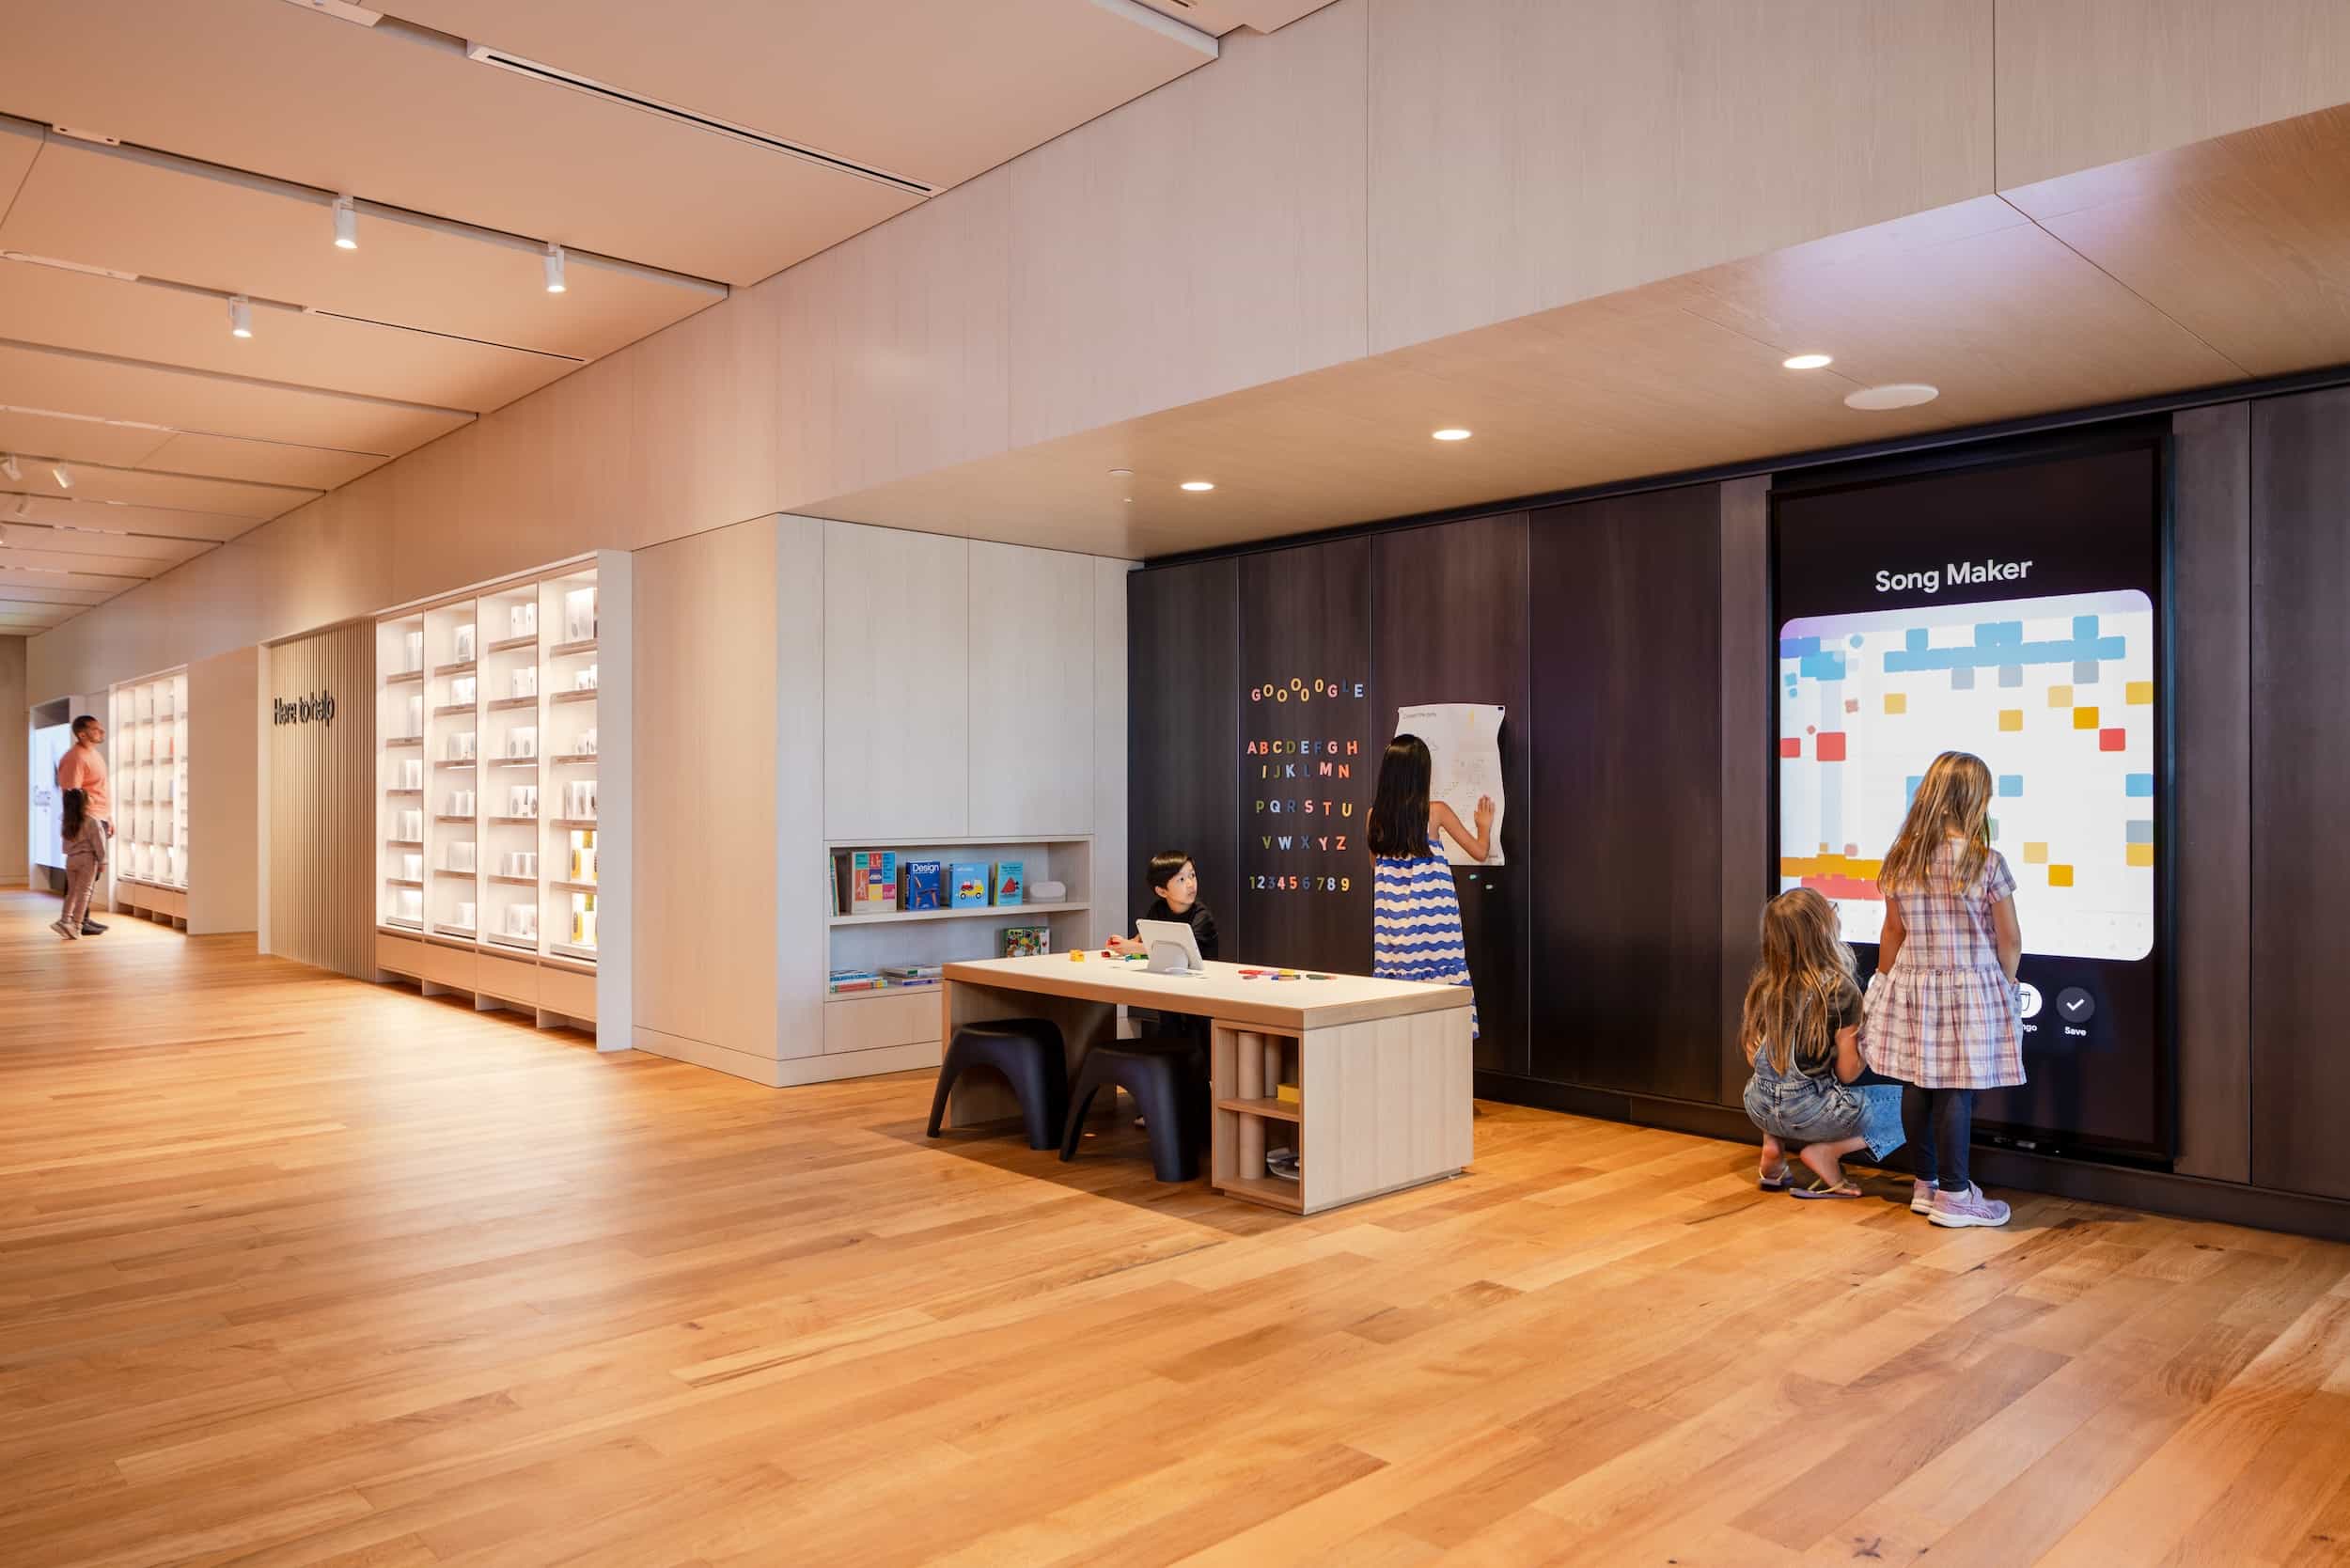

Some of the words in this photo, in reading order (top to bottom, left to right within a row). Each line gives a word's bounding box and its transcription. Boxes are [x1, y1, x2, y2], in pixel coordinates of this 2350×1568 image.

[1874, 570, 1939, 593] Song
[1947, 558, 2032, 586] Maker
[274, 697, 297, 726] Here
[299, 696, 311, 724] to
[310, 689, 335, 728] help
[912, 862, 940, 874] Design
[2022, 1024, 2038, 1033] ngo
[2064, 1026, 2087, 1037] Save
